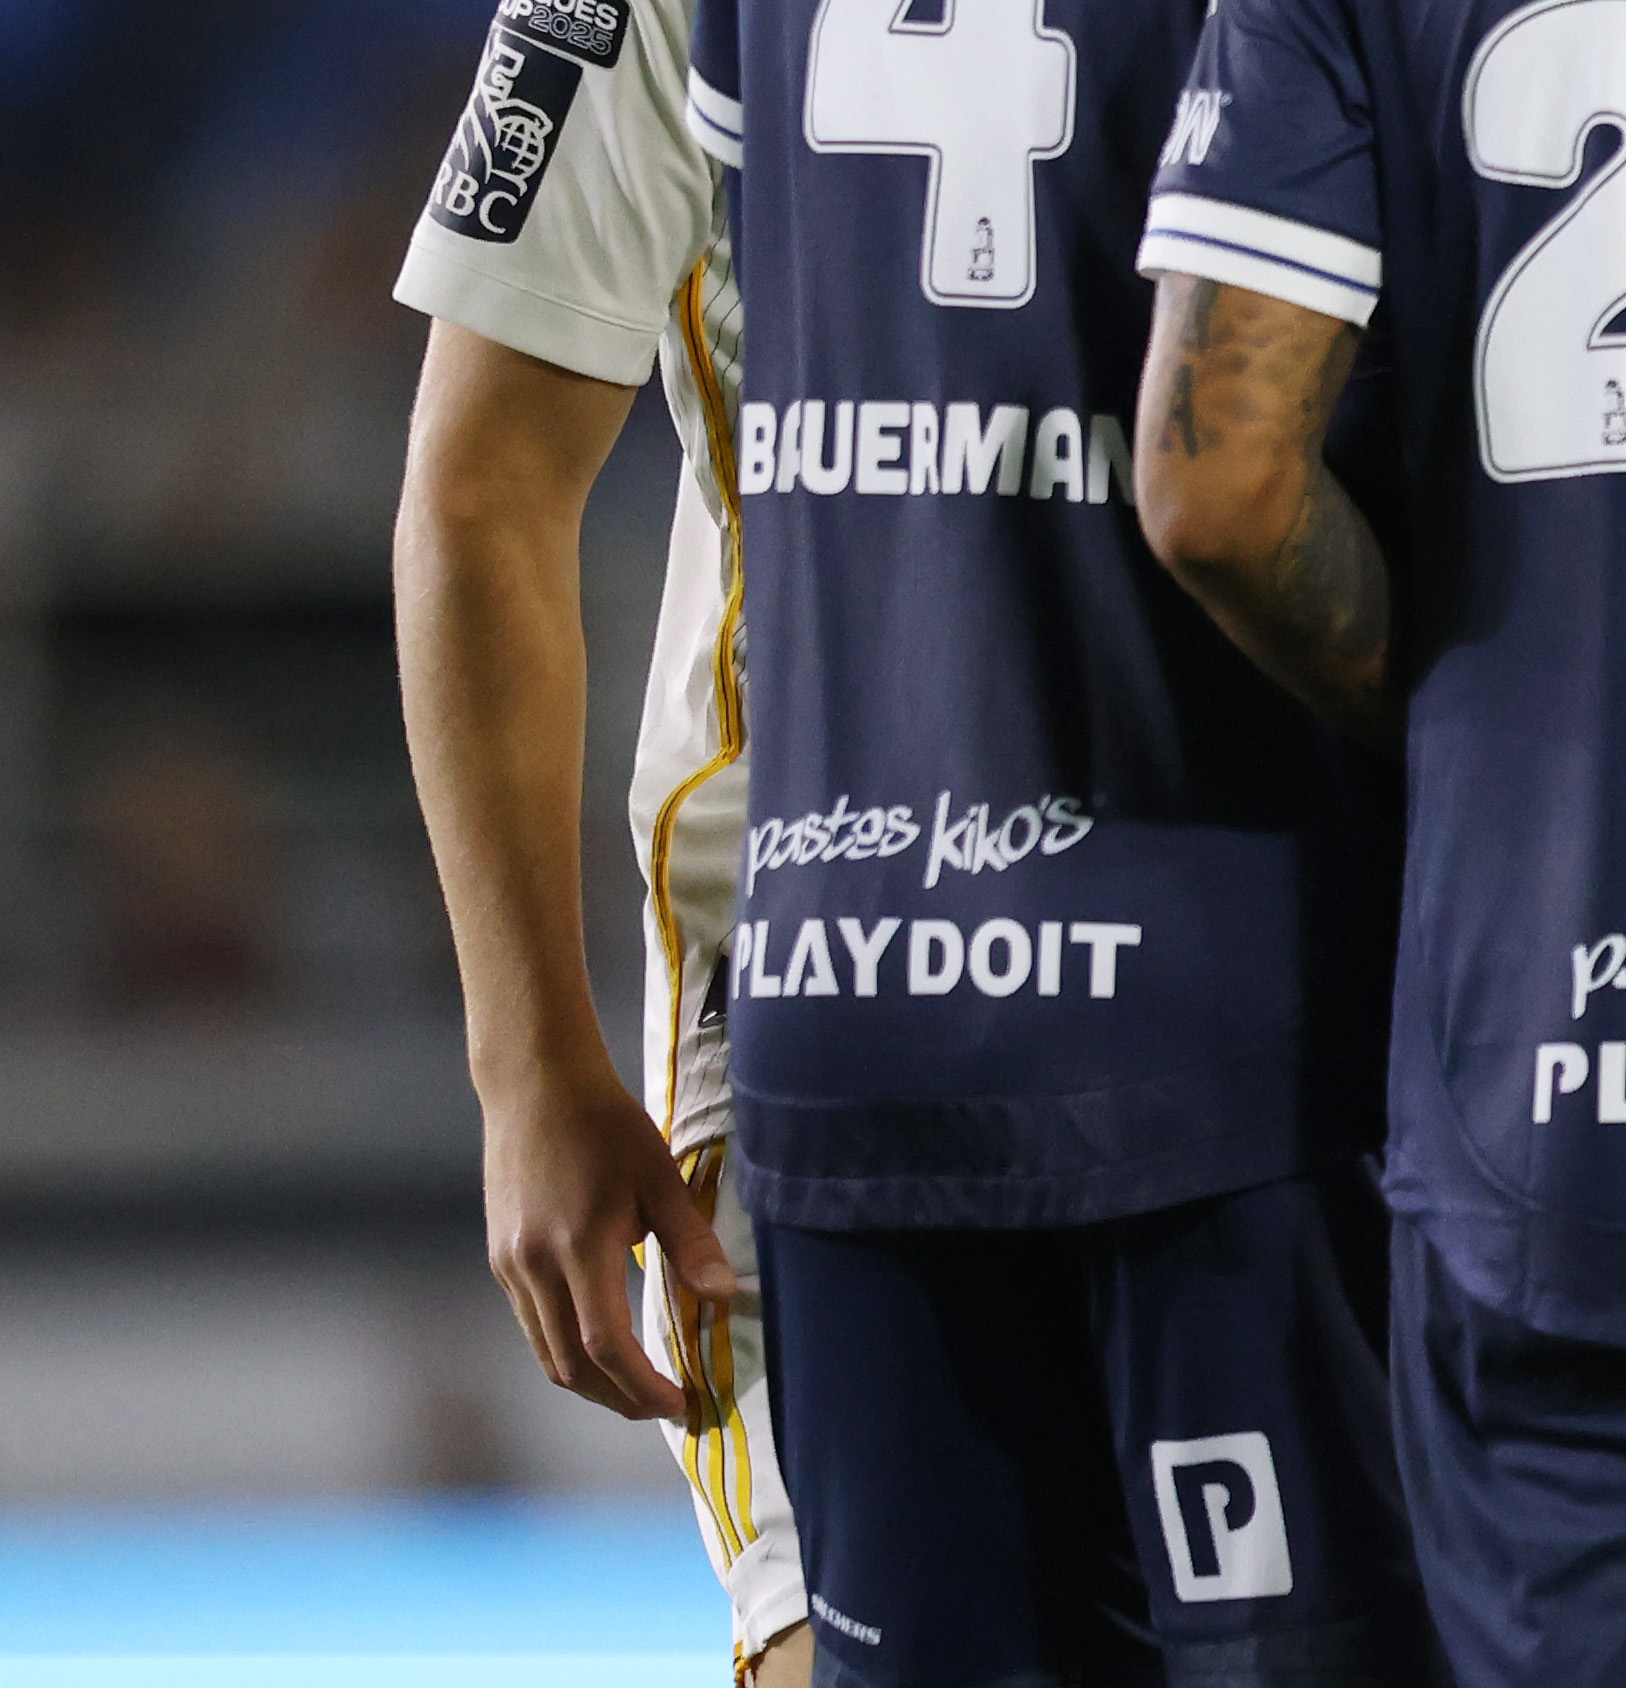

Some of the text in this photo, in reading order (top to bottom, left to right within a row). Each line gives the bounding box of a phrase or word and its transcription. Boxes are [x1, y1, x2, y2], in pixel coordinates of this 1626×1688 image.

[528, 5, 614, 56] 2025
[432, 160, 518, 235] RBC
[746, 794, 920, 898] pastes
[730, 917, 1142, 1000] PLAYDOIT
